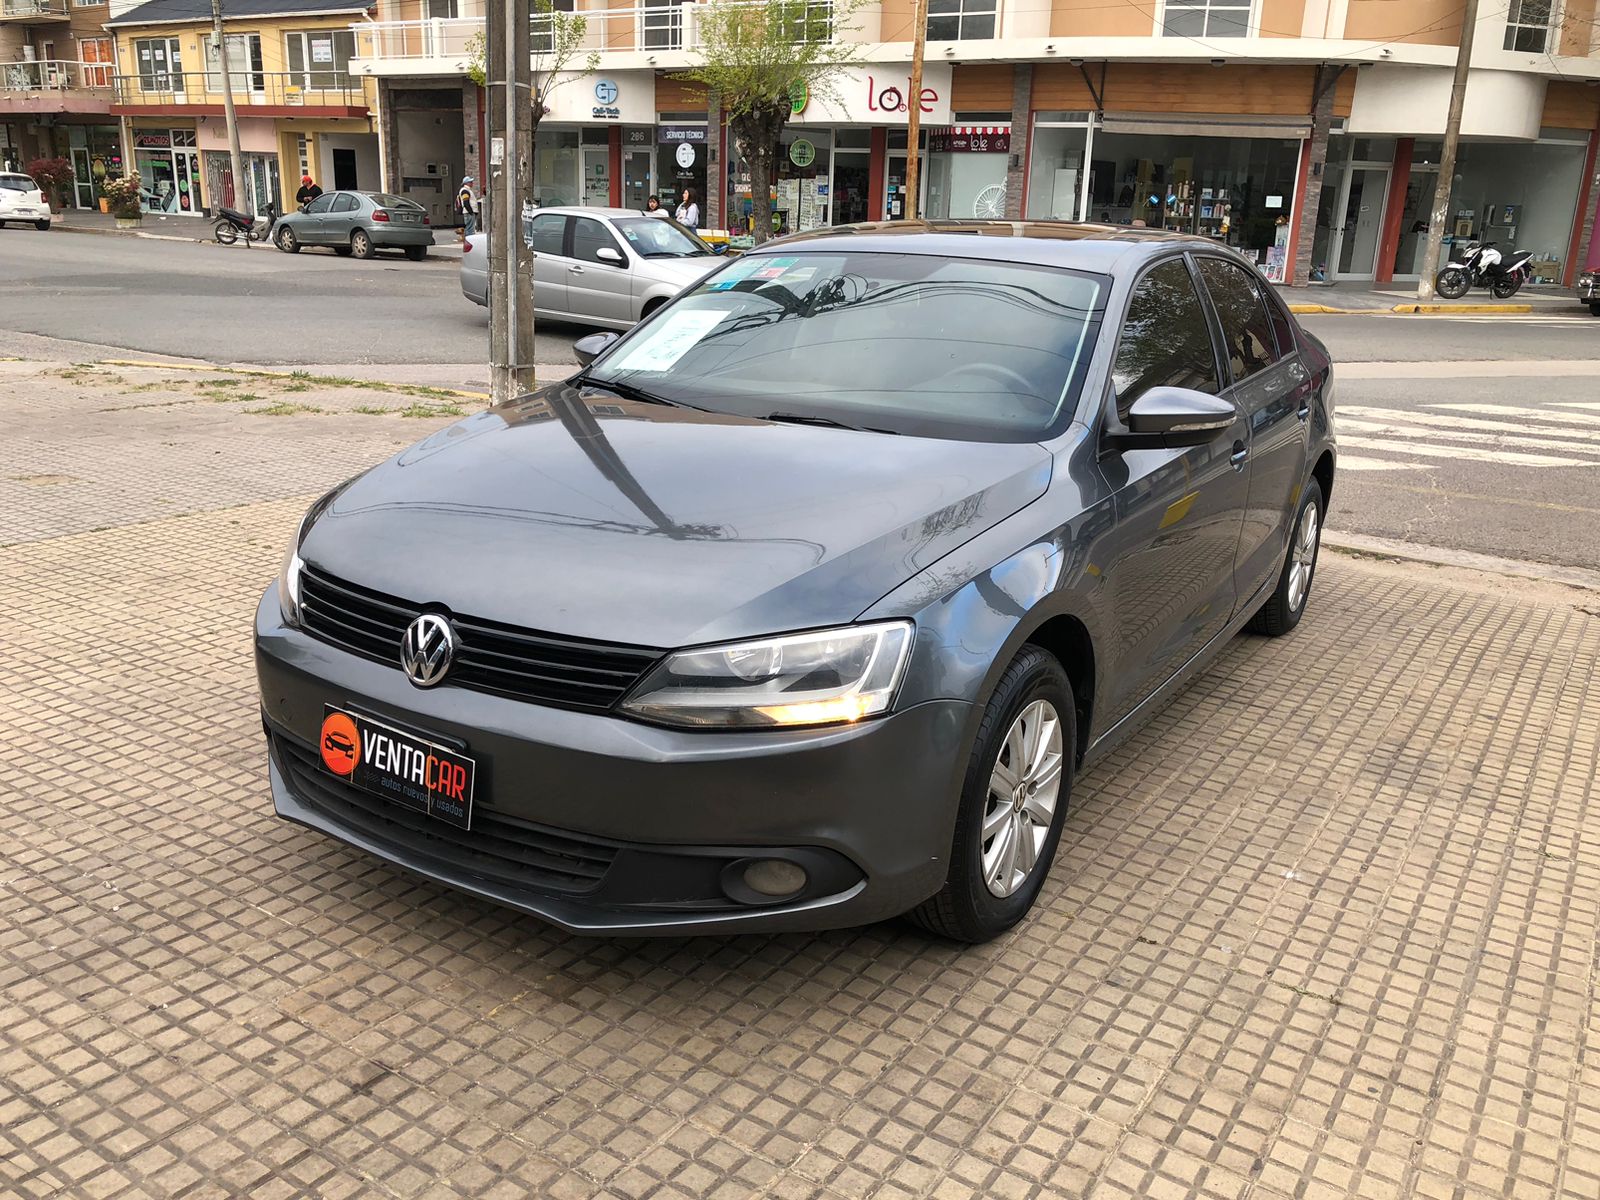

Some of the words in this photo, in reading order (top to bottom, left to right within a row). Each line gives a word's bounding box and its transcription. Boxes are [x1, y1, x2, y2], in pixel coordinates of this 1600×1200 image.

[666, 130, 686, 139] SERVICIO
[686, 130, 704, 140] TÉCNICO
[363, 728, 467, 802] VENTACAR
[380, 775, 402, 793] autos
[402, 782, 429, 804] nuevos
[430, 796, 436, 809] y
[436, 799, 464, 818] usados
